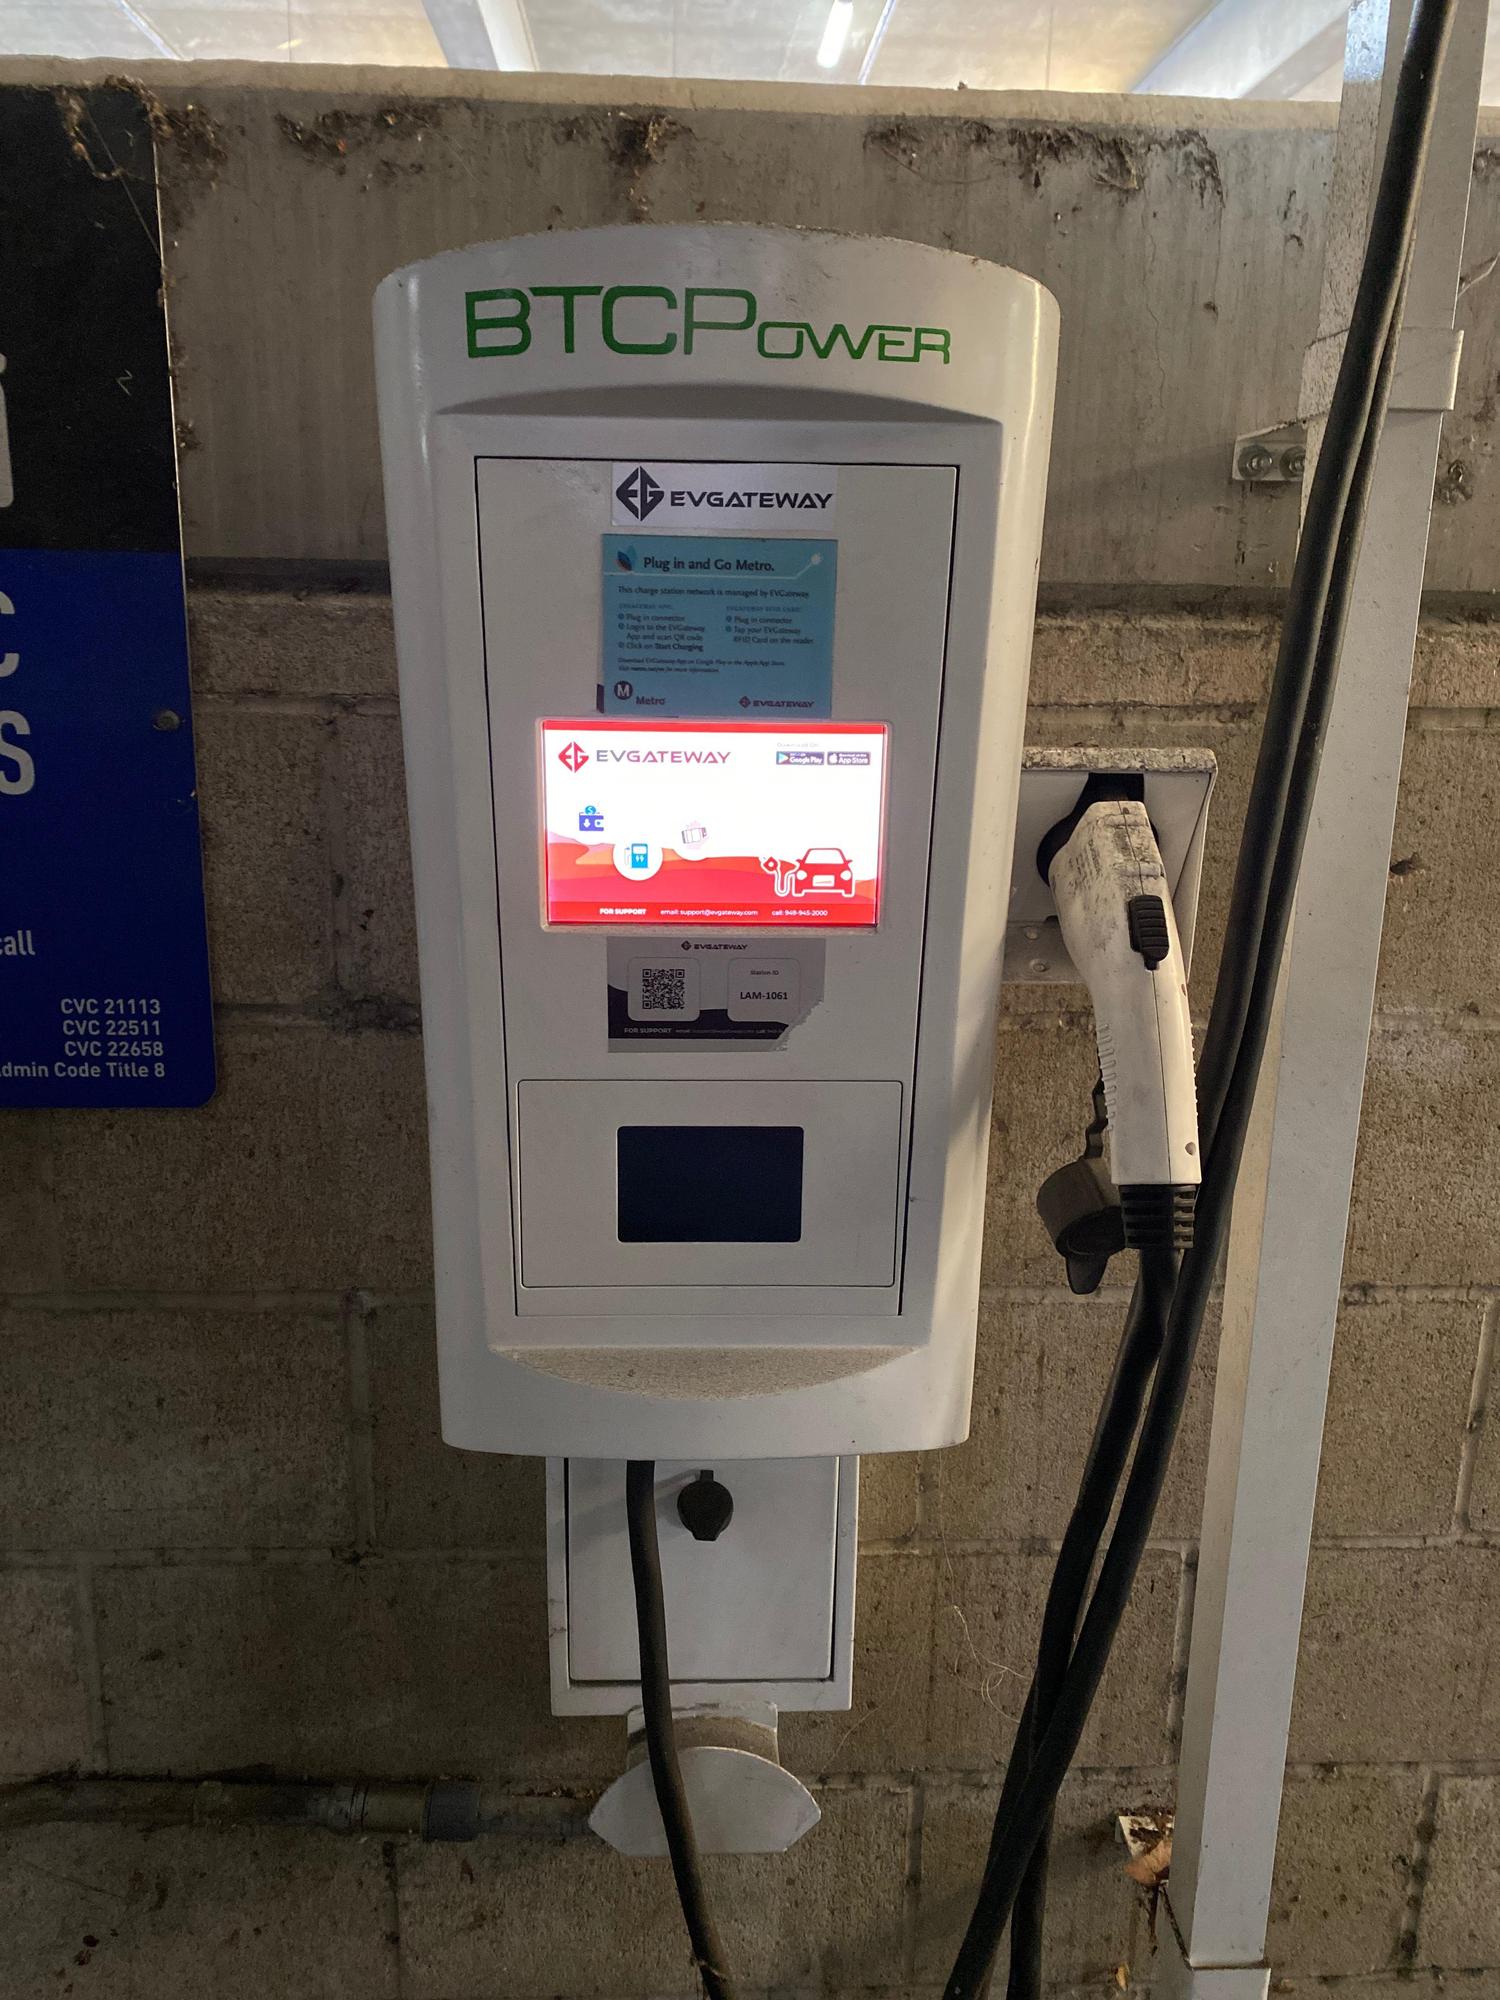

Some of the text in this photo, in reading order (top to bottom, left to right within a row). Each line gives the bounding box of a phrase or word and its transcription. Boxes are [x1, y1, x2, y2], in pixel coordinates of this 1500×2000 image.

[670, 491, 833, 510] EVGATEWAY
[643, 556, 775, 572] Plug in and Go Metro.
[618, 586, 633, 594] This
[634, 586, 659, 597] charge
[686, 588, 715, 596] network
[725, 589, 758, 598] managed
[760, 589, 769, 599] by
[636, 695, 665, 706] Metro
[752, 699, 815, 708] EVGATEWAY
[596, 750, 731, 764] EVGATEWAY
[789, 756, 823, 764] Google Play
[740, 991, 788, 1000] LAM-1061
[60, 998, 161, 1014] CVC 21113
[62, 1020, 160, 1035] CVC 22511
[64, 1041, 164, 1057] CVC 22658
[0, 1062, 165, 1077] dmin Code Title 8
